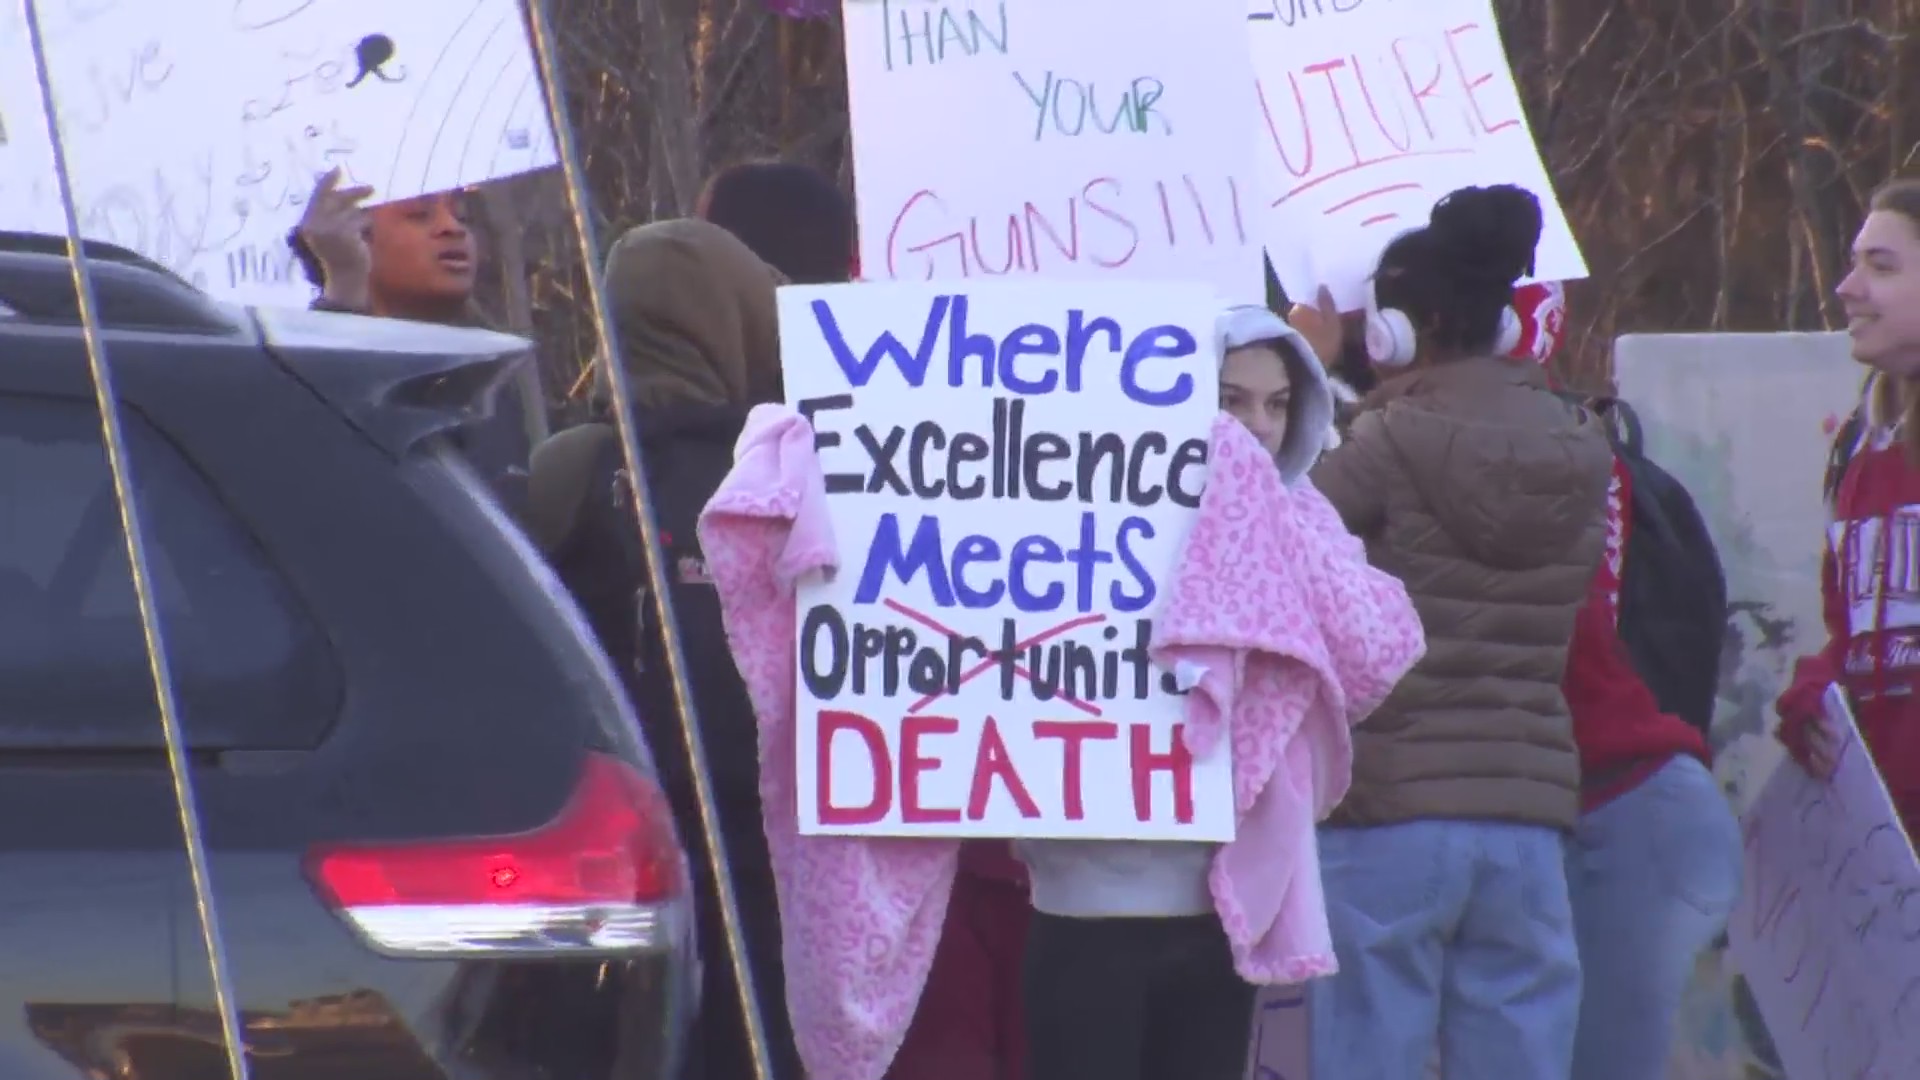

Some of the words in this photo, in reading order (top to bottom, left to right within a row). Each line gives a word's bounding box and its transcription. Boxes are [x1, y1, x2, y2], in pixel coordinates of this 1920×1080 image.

[883, 0, 1008, 70] THAN
[1012, 70, 1173, 141] YOUR
[1255, 23, 1521, 177] UTURE
[811, 294, 1196, 406] Where
[798, 395, 1208, 507] Excellence
[853, 511, 1156, 612] Meets
[817, 710, 1194, 824] DEATH
